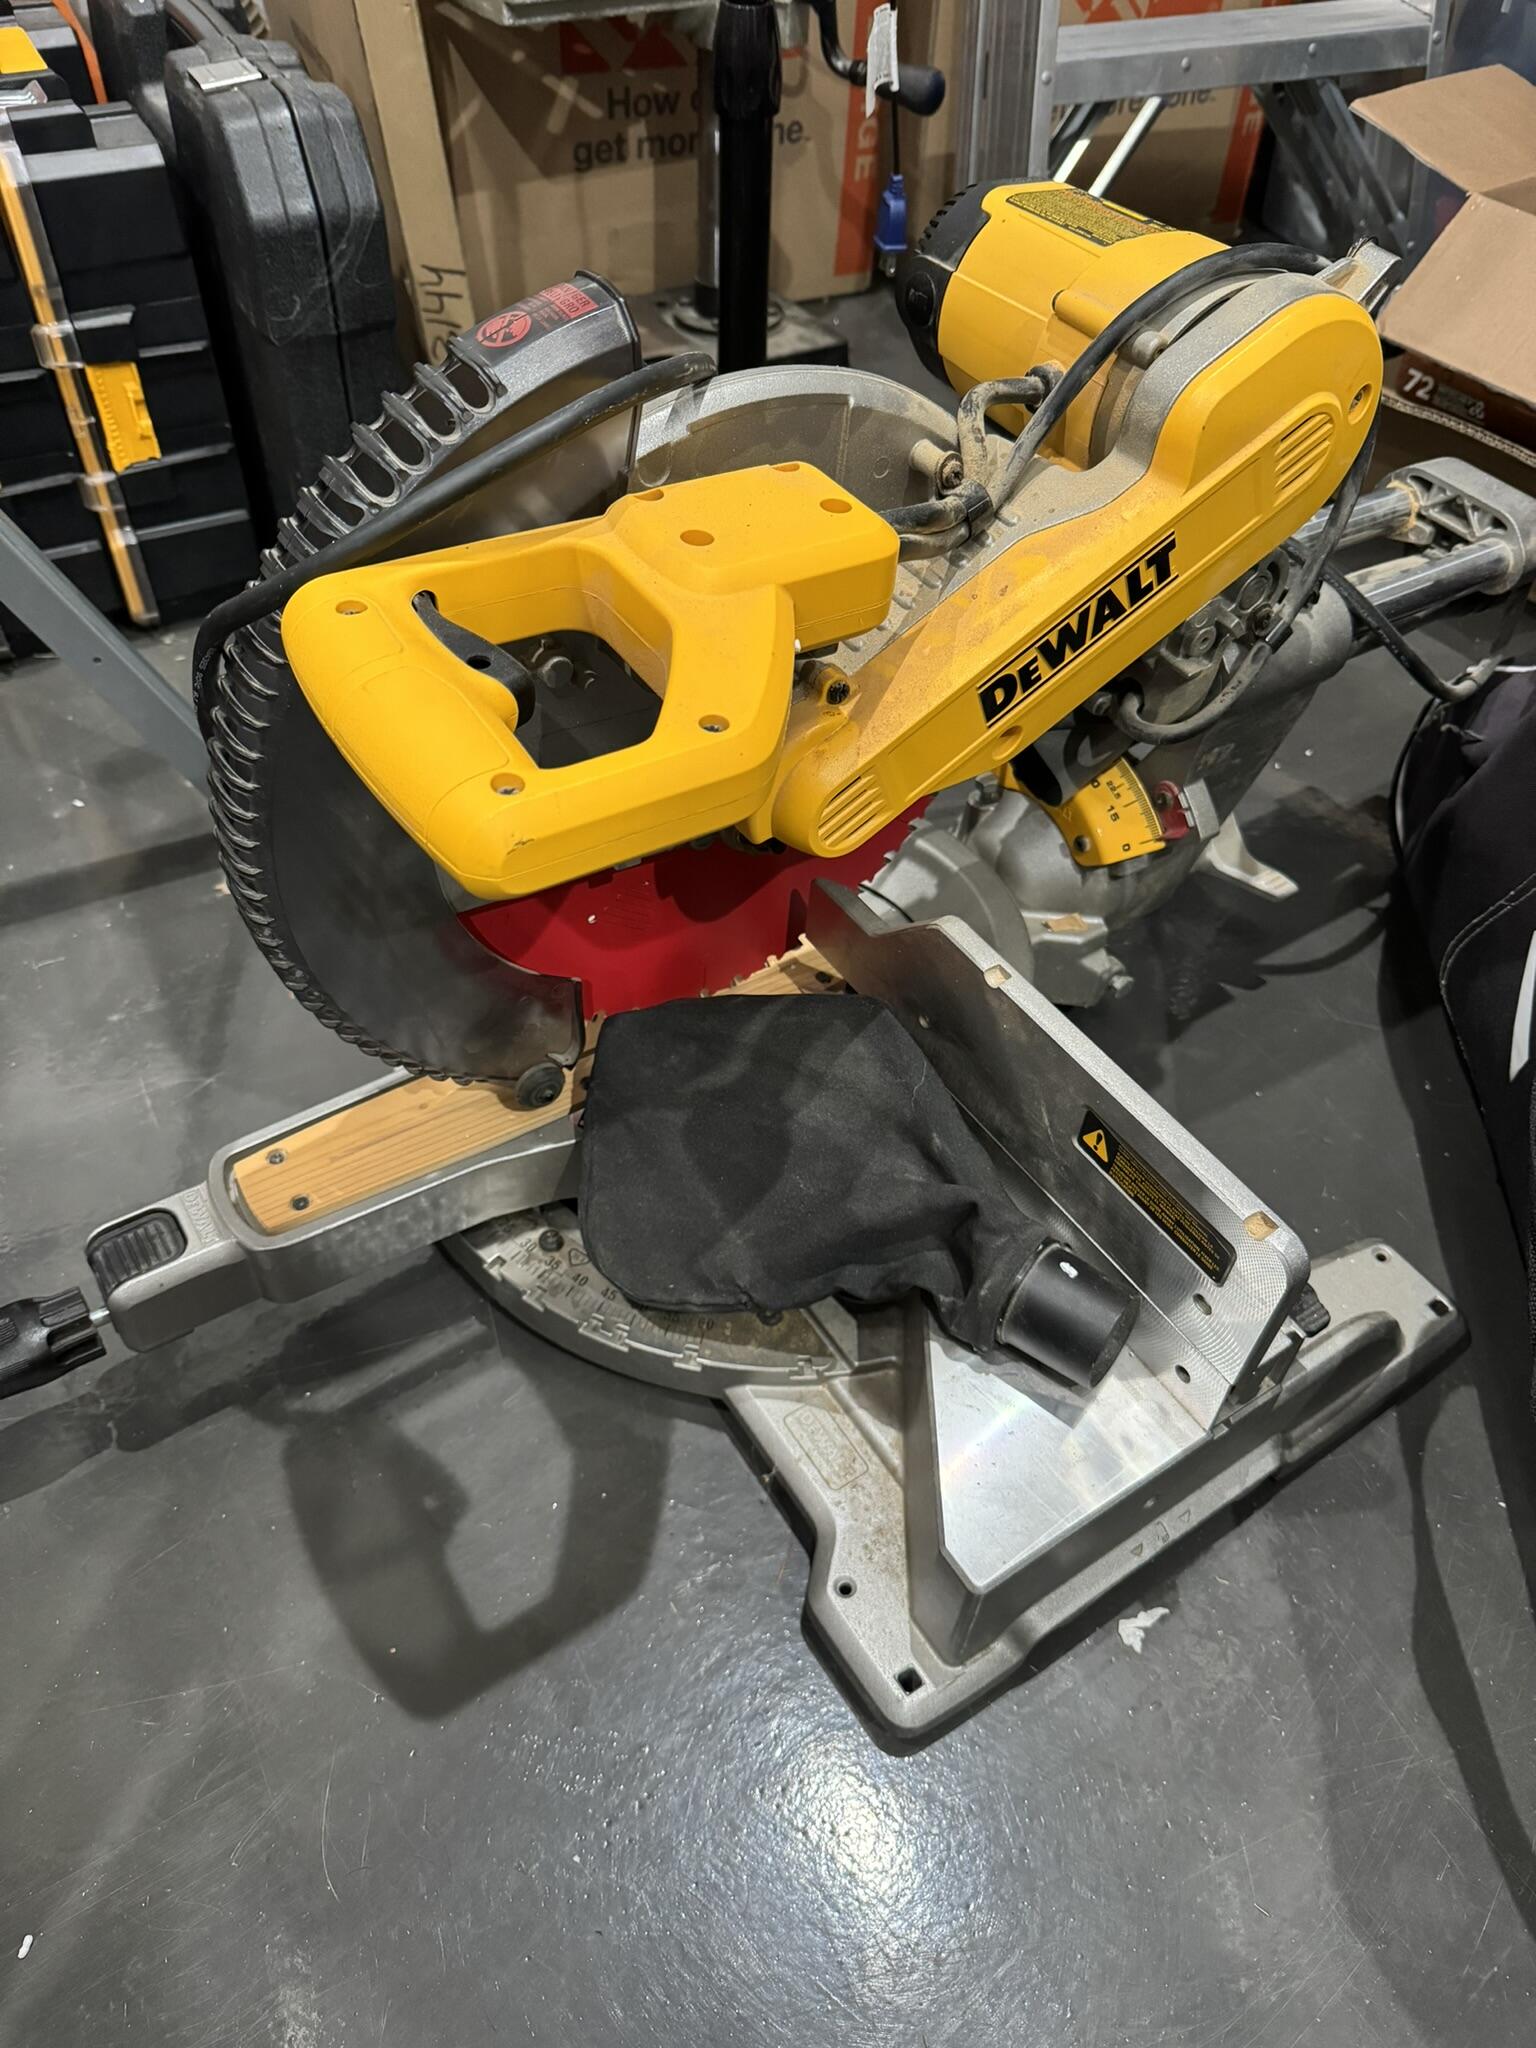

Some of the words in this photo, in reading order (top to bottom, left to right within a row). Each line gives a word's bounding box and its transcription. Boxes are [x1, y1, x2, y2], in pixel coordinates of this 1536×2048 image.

[607, 86, 681, 120] How
[573, 130, 629, 173] get
[637, 130, 699, 161] mor
[1402, 367, 1435, 401] 72
[978, 537, 1177, 723] DEWALT
[1106, 804, 1121, 822] 15
[1122, 843, 1132, 852] 0
[544, 1255, 562, 1270] 35
[571, 1273, 589, 1287] 40
[600, 1287, 617, 1301] 45
